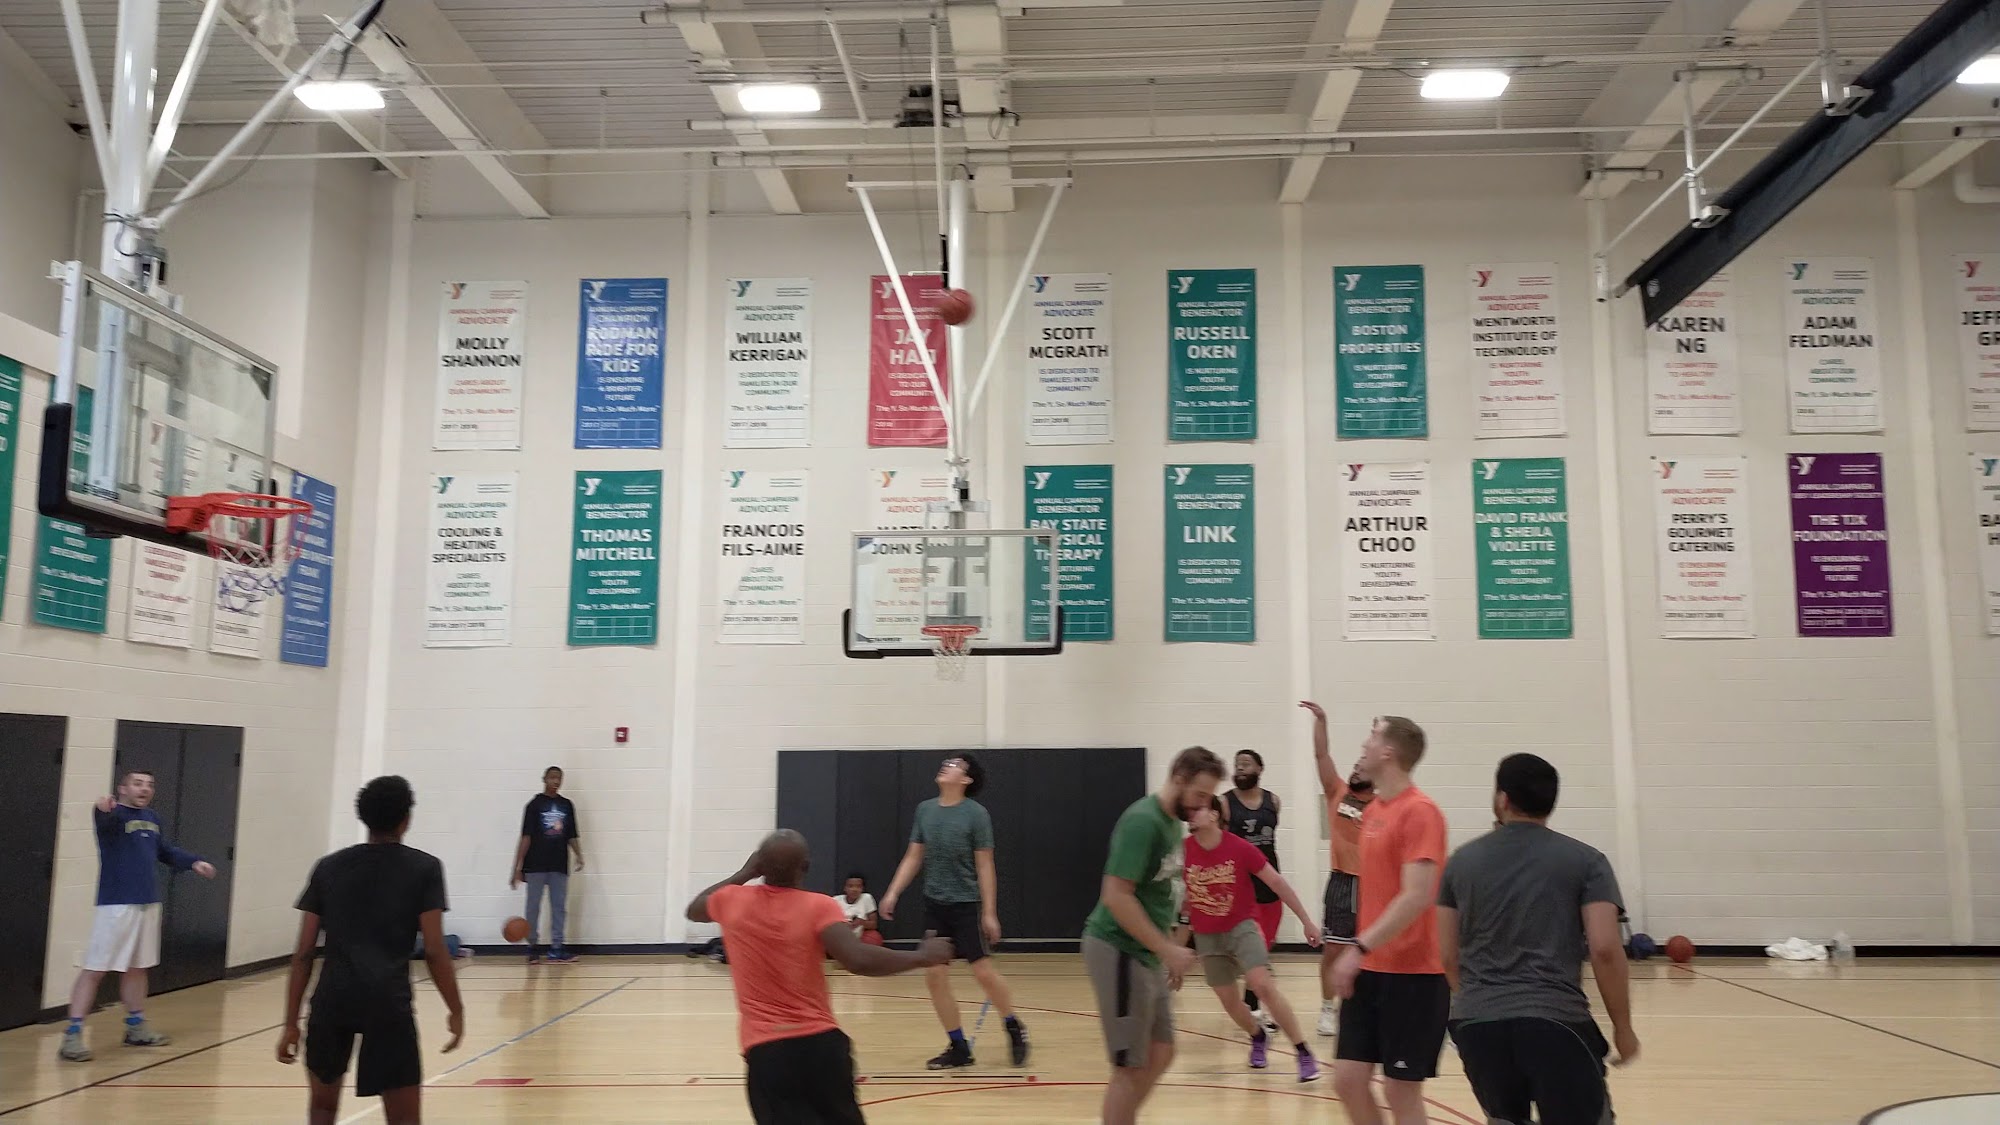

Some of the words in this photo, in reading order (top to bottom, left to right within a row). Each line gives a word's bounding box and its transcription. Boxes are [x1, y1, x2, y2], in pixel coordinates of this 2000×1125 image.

[1802, 297, 1856, 305] ADVOCATE
[1348, 306, 1411, 314] BENEFACTOR
[1488, 303, 1541, 311] ADVOCATE
[1181, 309, 1242, 317] BENEFACTOR
[1473, 316, 1556, 327] WENTWORTH
[1656, 317, 1725, 332] KAREN
[1803, 316, 1857, 329] ADAM
[588, 328, 658, 339] RODMAN
[1042, 328, 1095, 340] SCOTT
[1174, 327, 1250, 340] RUSSELL
[1352, 325, 1408, 335] BOSTON
[736, 332, 802, 344] WILLIAM
[1473, 332, 1538, 342] INSTITUTE
[1540, 331, 1558, 340] OF
[1789, 335, 1873, 347] FELDMAN
[456, 338, 509, 350] MOLLY
[1339, 343, 1421, 354] PROPERTIES
[1676, 338, 1706, 353] NG
[586, 344, 622, 356] RIDE
[626, 344, 659, 356] FOR
[729, 350, 808, 361] KERRIGAN
[1029, 346, 1109, 358] MCGRATH
[1187, 346, 1237, 358] OKEN
[1474, 346, 1557, 356] TECHNOLOGY
[442, 355, 521, 367] SHANNON
[602, 360, 640, 372] KIDS
[1358, 499, 1412, 507] ADVOCATE
[1483, 496, 1557, 504] BENEFACTORS
[739, 505, 790, 513] ADVOCATE
[586, 511, 649, 519] BENEFACTOR
[1476, 513, 1517, 523] DAVID
[1519, 512, 1568, 523] FRANK
[1672, 514, 1728, 523] PERRY'S
[1808, 515, 1840, 525] THE
[1030, 520, 1059, 530] BAY
[1062, 519, 1106, 530] STATE
[1345, 517, 1427, 531] ARTHUR
[438, 528, 490, 537] COOLING
[495, 527, 503, 536] &
[580, 529, 652, 542] THOMAS
[722, 524, 804, 537] FRANCOIS
[1184, 526, 1237, 543] LINK
[1490, 527, 1502, 537] &
[1504, 526, 1553, 537] SHEILA
[1667, 527, 1734, 538] GOURMET
[1793, 530, 1887, 541] FOUNDATION
[444, 540, 496, 549] HEATING
[722, 543, 804, 556] FILS-AIME
[872, 544, 910, 554] JOHN
[1359, 537, 1415, 552] CHOO
[1488, 541, 1556, 551] VIOLETTE
[1668, 542, 1735, 552] CATERING
[432, 553, 506, 563] SPECIALISTS
[576, 548, 655, 560] MITCHELL
